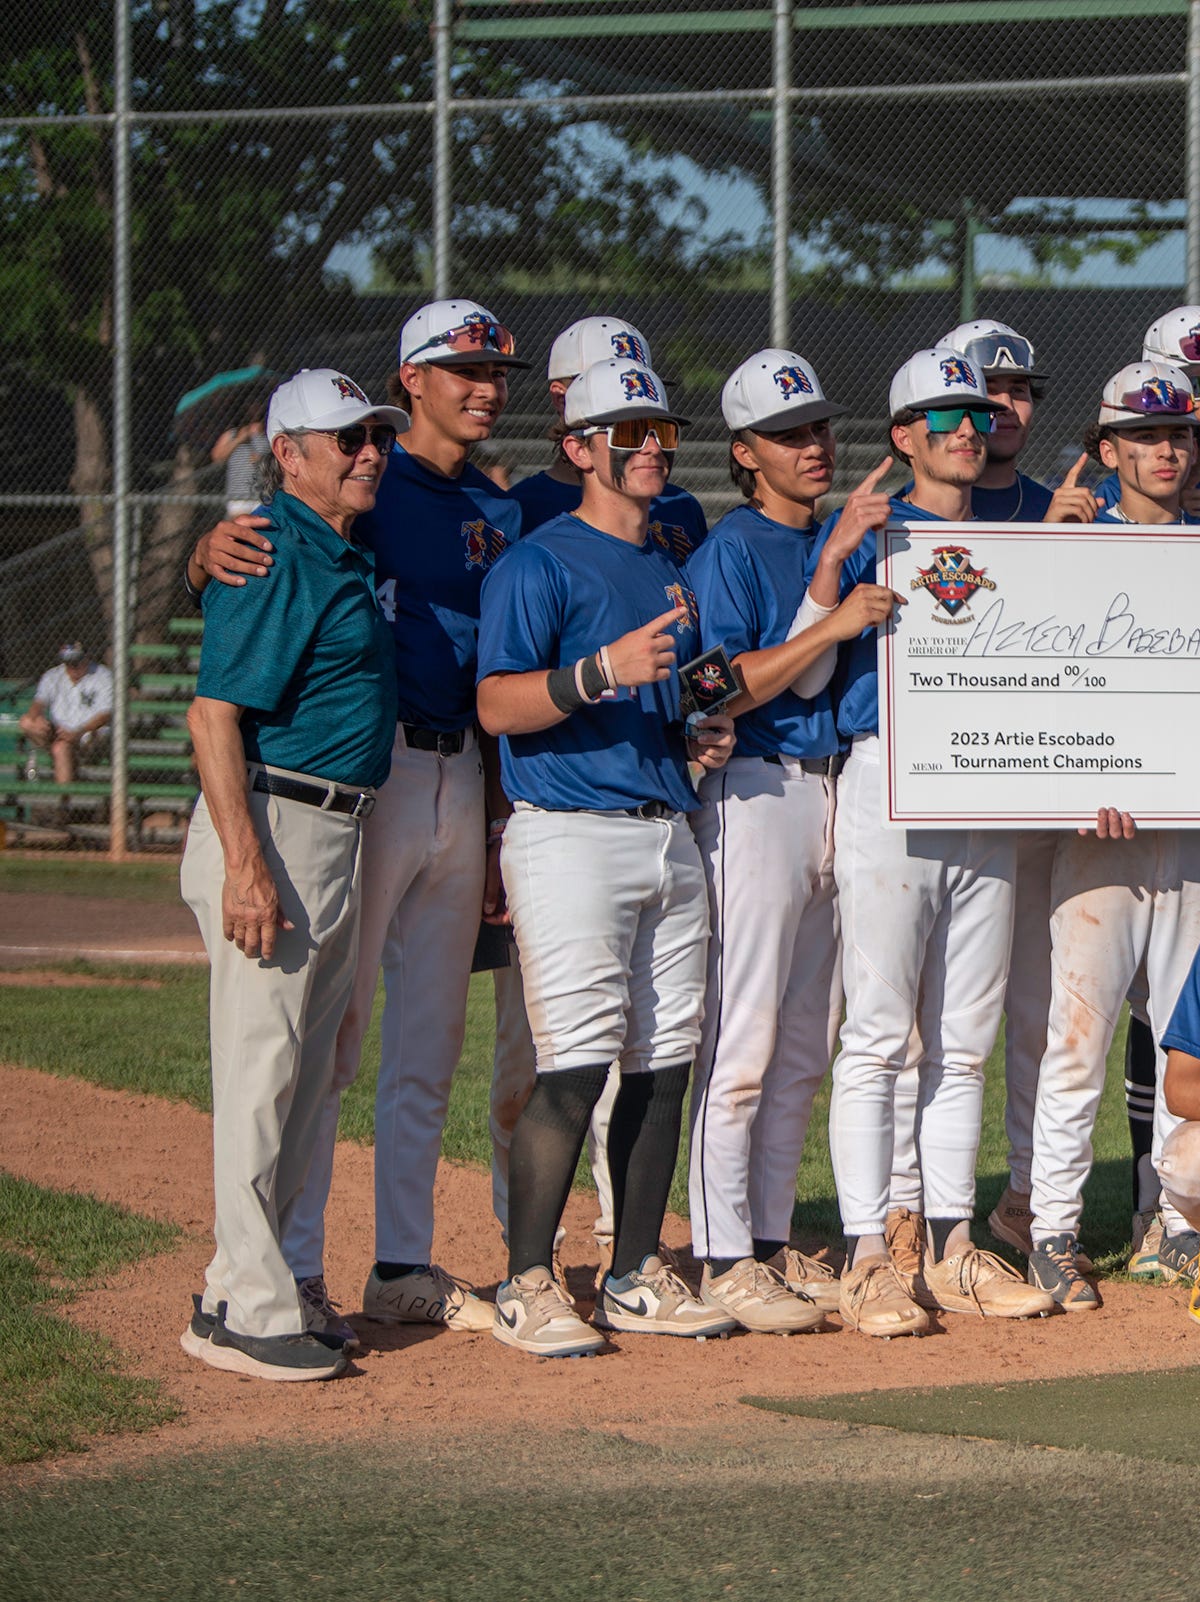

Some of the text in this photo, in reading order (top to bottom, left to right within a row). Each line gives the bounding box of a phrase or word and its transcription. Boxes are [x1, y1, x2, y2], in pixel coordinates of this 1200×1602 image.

[910, 572, 941, 591] ARTIE
[942, 571, 997, 592] ESCOBADO
[930, 613, 976, 626] TOURNAMENT
[909, 637, 968, 646] PAY TO THE
[908, 647, 958, 655] ORDER OF
[909, 672, 943, 687] Two
[947, 672, 1027, 687] Thousand
[1031, 673, 1060, 687] and
[951, 732, 1115, 746] 2023 Artie Escobado
[912, 763, 943, 771] MEMO
[951, 754, 1143, 771] Tournament Champions
